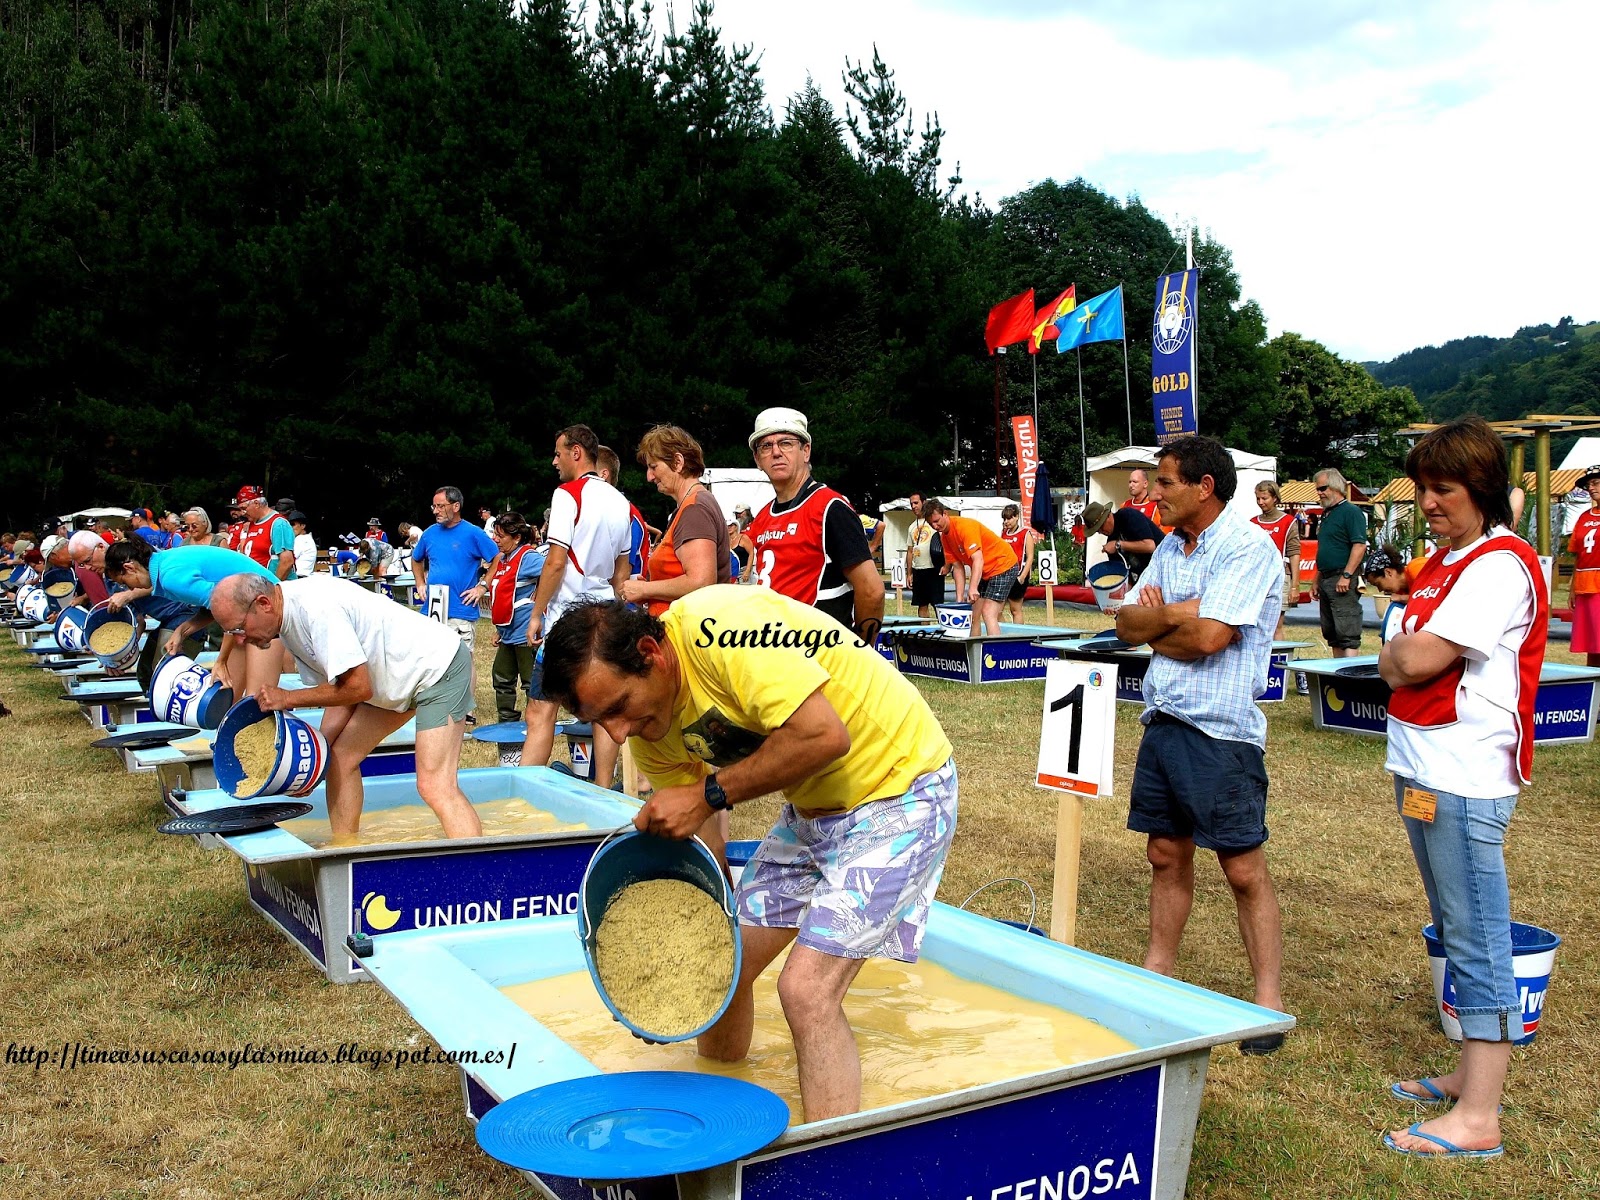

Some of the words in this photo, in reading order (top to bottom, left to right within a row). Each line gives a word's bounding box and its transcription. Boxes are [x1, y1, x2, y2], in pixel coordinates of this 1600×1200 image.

[1152, 372, 1189, 393] GOLD
[891, 565, 903, 582] 10
[1040, 558, 1053, 580] 8
[910, 654, 935, 670] UNION
[935, 657, 969, 675] FENOSA
[999, 658, 1028, 670] UNION
[1030, 657, 1060, 668] FEN
[1546, 709, 1587, 724] FENOSA
[1050, 684, 1084, 774] 1
[258, 864, 286, 909] UNION
[284, 885, 322, 941] FENOSA
[414, 899, 502, 930] UNION
